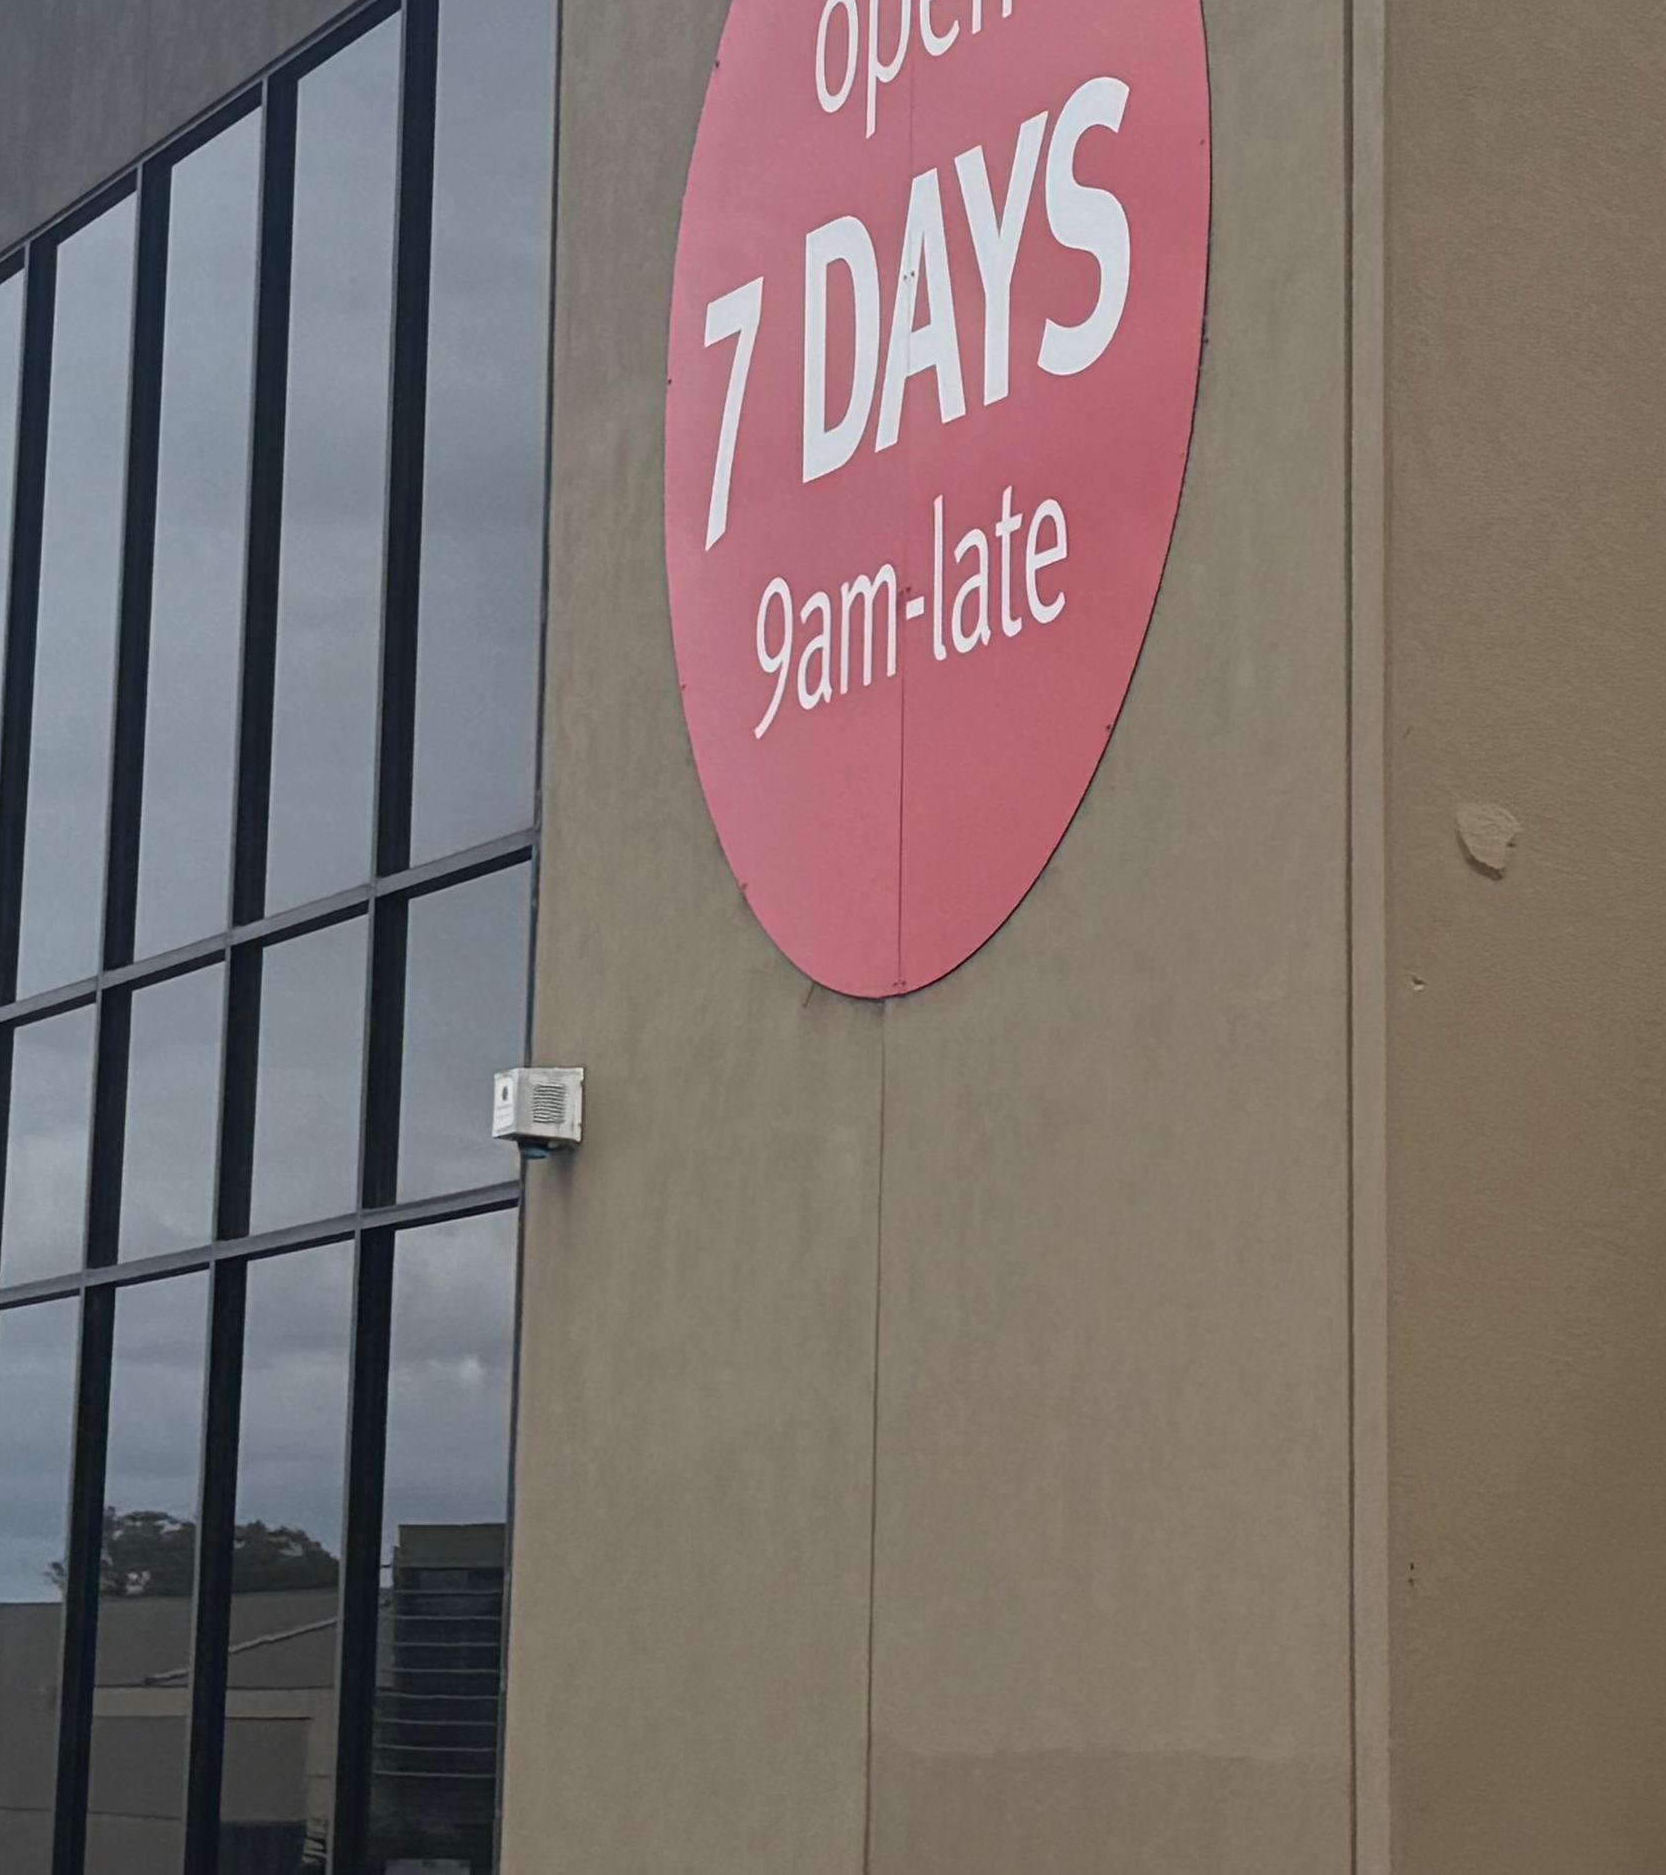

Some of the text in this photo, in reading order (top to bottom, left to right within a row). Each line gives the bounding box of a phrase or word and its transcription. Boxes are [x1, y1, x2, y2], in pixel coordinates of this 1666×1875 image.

[704, 76, 1131, 551] 7 DAYS
[754, 485, 1069, 738] 9am-late
